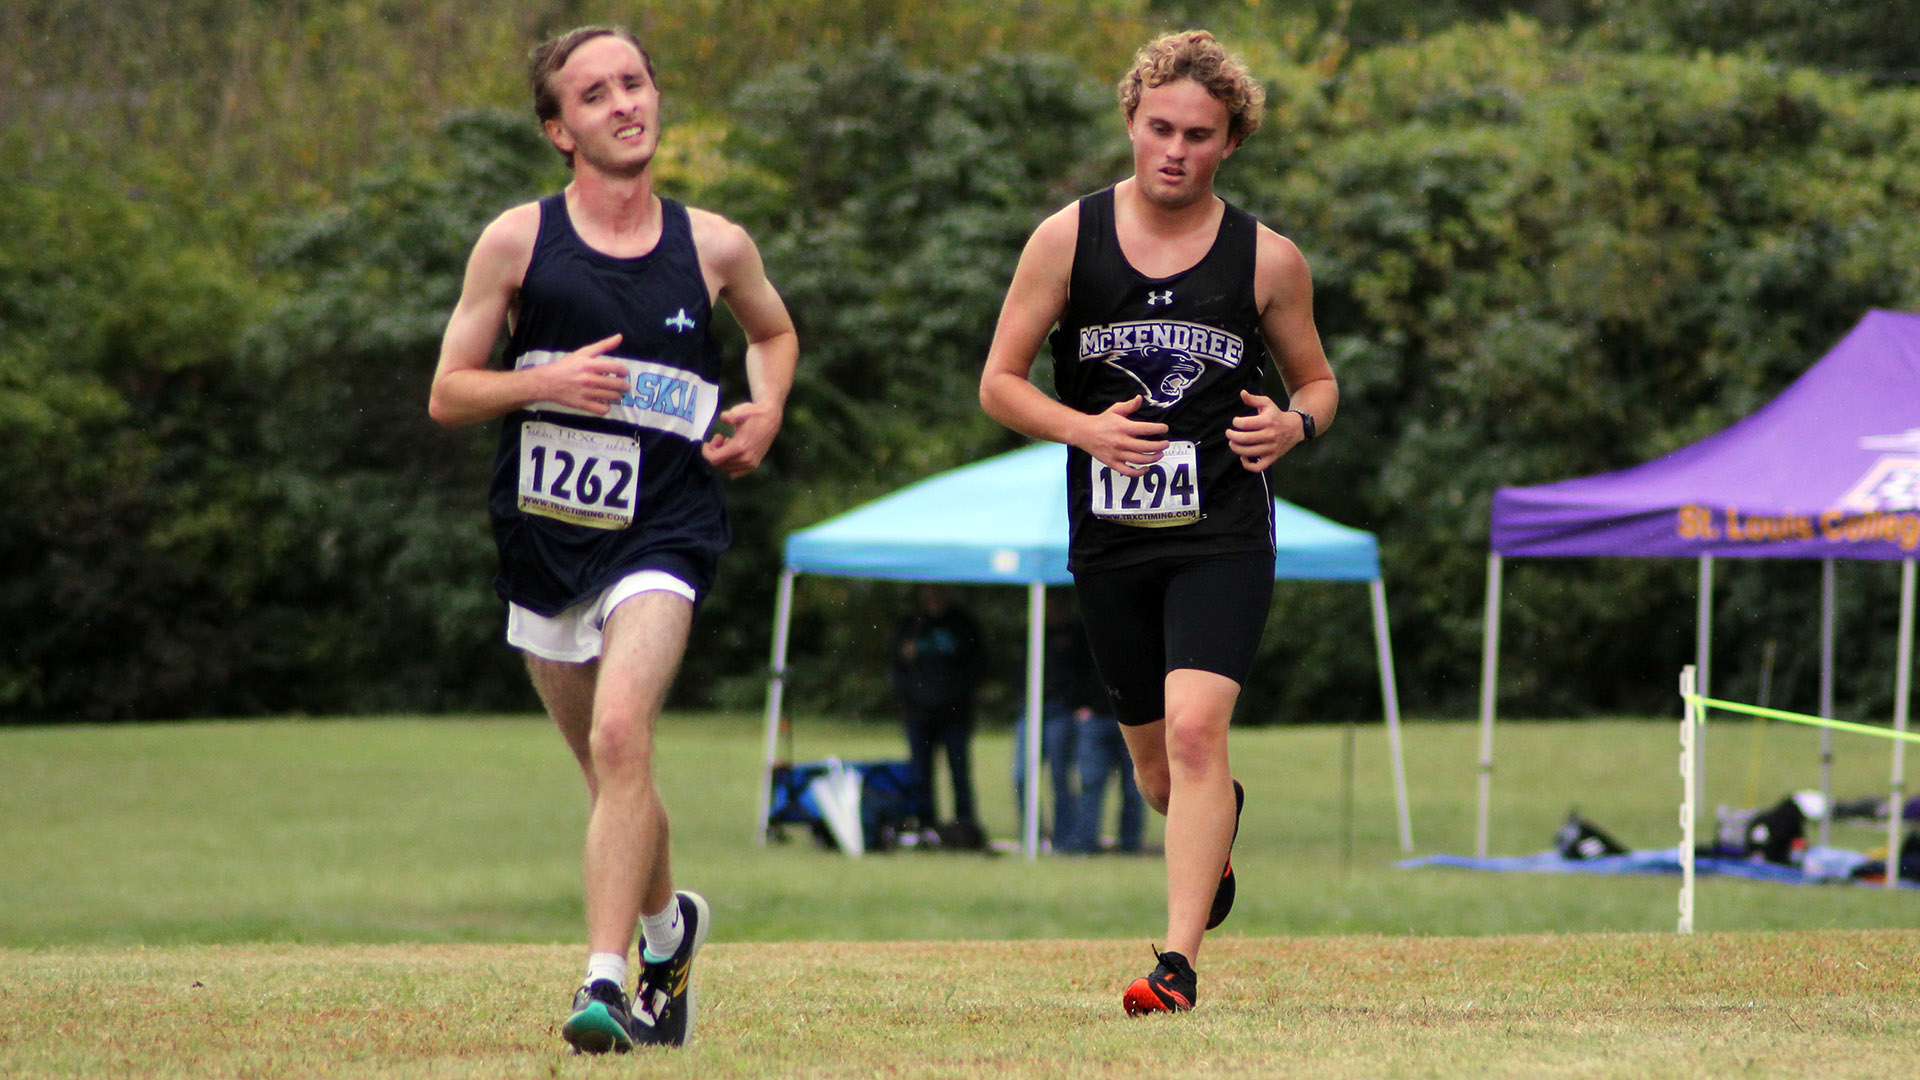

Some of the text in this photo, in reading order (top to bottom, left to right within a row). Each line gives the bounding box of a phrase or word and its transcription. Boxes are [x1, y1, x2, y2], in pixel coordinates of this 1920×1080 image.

[1080, 320, 1242, 367] McKENDREE
[530, 445, 633, 510] 1262
[1100, 463, 1194, 510] 1294
[522, 495, 629, 522] WWW.TRXCTIMING.COM
[1097, 510, 1196, 521] WWW.TRXCTIMING.COM
[1678, 503, 1920, 551] St. Louis Colleg
